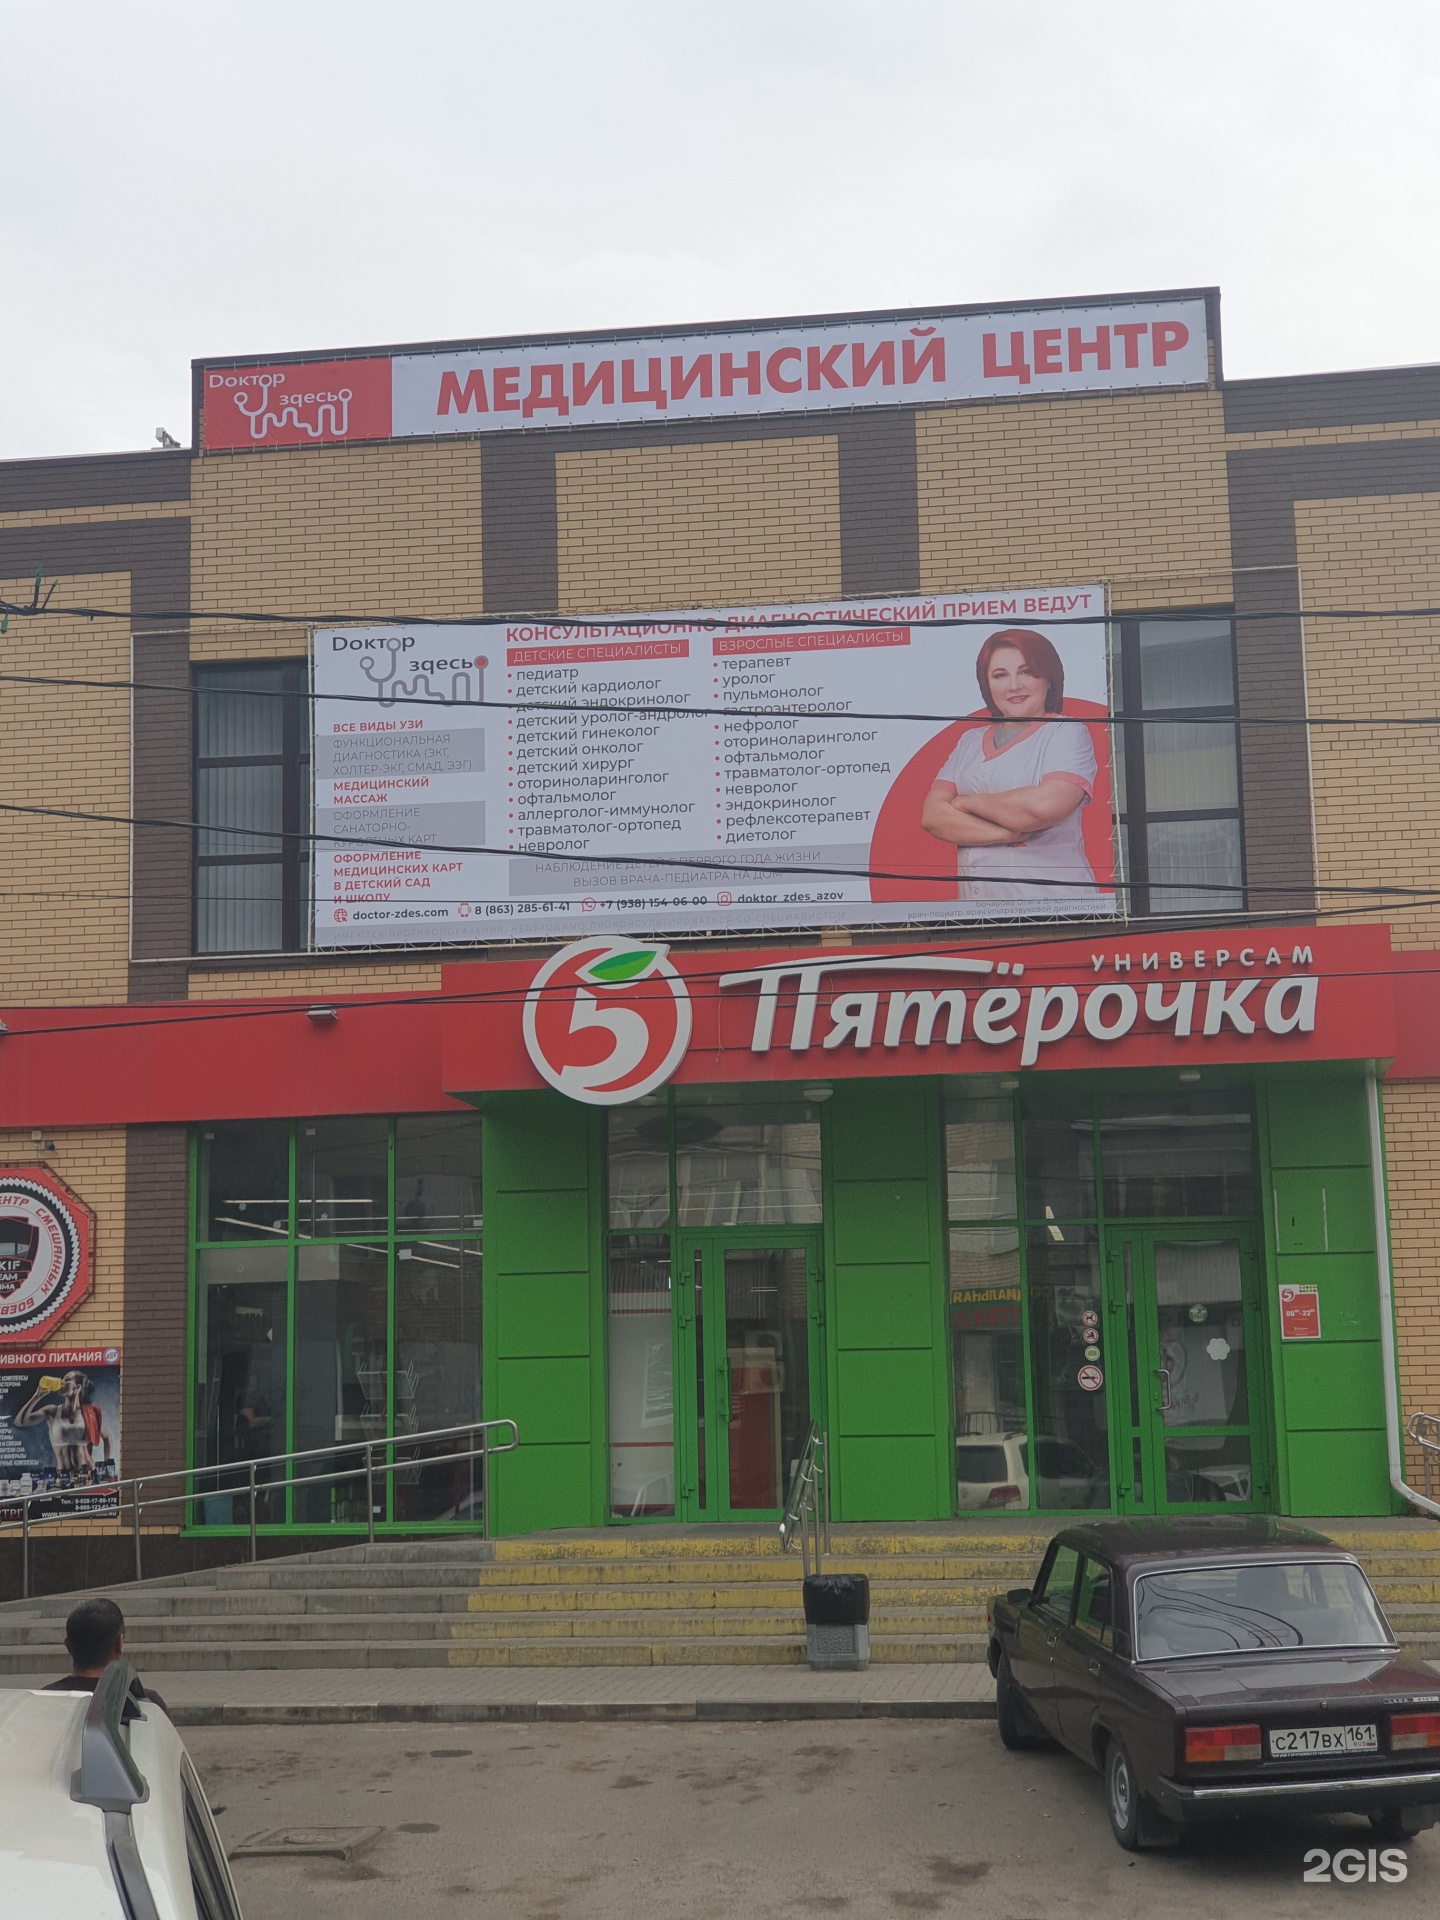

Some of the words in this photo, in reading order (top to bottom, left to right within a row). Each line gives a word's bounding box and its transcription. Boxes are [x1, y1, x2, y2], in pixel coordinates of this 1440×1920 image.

[436, 327, 947, 419] МЕДИЦИНСКИЙ
[982, 320, 1190, 385] ЦЕНТР
[943, 599, 1017, 618] ПРИЕМ
[1023, 594, 1092, 614] ВЕДУТ
[719, 637, 794, 651] ВЗРОСЛЫЕ
[797, 631, 903, 648] СПЕЦИАЛИСТЫ
[513, 649, 574, 663] ДЕТСКИЕ
[577, 643, 681, 659] СПЕЦИАЛИСТЫ
[722, 657, 791, 671] терапевт
[516, 668, 579, 681] педиатр
[722, 673, 776, 688] уролог
[516, 682, 577, 698] детский
[581, 679, 662, 693] кардиолог
[723, 686, 824, 703] пульмонолог
[582, 694, 691, 709] эндокринолог
[333, 722, 356, 732] ВСЕ
[359, 721, 396, 732] ВИДЫ
[400, 720, 423, 730] УЗИ
[516, 713, 577, 729] детский
[724, 719, 800, 733] нефролог
[333, 734, 450, 749] ФУНКЦИОНАЛЬНАЯ
[516, 728, 578, 744] детский
[582, 725, 660, 739] гинеколог
[724, 731, 878, 749] оториноларинголог
[333, 749, 421, 763] ДИАГНОСТИКА
[516, 744, 578, 760] детский
[582, 743, 644, 754] онколог
[724, 749, 825, 765] офтальмолог
[447, 759, 472, 771] ЭЭГ)
[516, 760, 578, 775] детский
[582, 758, 634, 773] хирург
[724, 762, 891, 781] травматолог-ортопед
[333, 776, 429, 791] МЕДИЦИНСКИЙ
[517, 772, 669, 791] оториноларинголог
[725, 782, 798, 796] невролог
[333, 794, 388, 804] МАССАЖ
[517, 791, 617, 807] офтальмолог
[725, 796, 837, 812] эндокринолог
[333, 808, 420, 821] ОФОРМЛЕНИЕ
[517, 802, 696, 821] аллерголог-иммунолог
[726, 810, 871, 828] рефлексотерапевт
[333, 822, 411, 834] САНАТОРНО-
[518, 819, 682, 838] травматолог-ортопед
[408, 834, 436, 844] КАРТ
[725, 830, 797, 844] диетолог
[518, 839, 590, 853] невролог
[333, 851, 421, 863] ОФОРМЛЕНИЕ
[536, 861, 622, 873] НАБЛЮДЕНИЕ
[740, 853, 772, 864] ГОДА
[775, 851, 821, 862] ЖИЗНИ
[333, 864, 429, 877] МЕДИЦИНСКИХ
[432, 862, 463, 873] КАРТ
[333, 881, 341, 891] В
[344, 877, 401, 891] ДЕТСКИЙ
[405, 878, 431, 888] САД
[573, 876, 617, 887] ВЫЗОВ
[621, 871, 730, 885] ВРАЧА-ПЕДИАТРА
[733, 870, 750, 880] НА
[346, 893, 391, 904] ШКОЛУ
[600, 900, 613, 909] +7
[616, 898, 646, 911] (938)
[353, 907, 449, 921] doctor-zdes.com
[475, 906, 482, 915] 8
[485, 904, 514, 917] (863)
[517, 902, 570, 914] 285-61-41
[986, 904, 1051, 916] ультразвуковой
[1053, 902, 1107, 913] диагностики
[1091, 944, 1315, 974] УНИВЕРСАМ
[719, 953, 1320, 1067] Пятёрочка
[49, 1351, 102, 1363] ПИТАНИЯ
[1276, 1731, 1344, 1751] С217ВХ
[1347, 1726, 1373, 1742] 161
